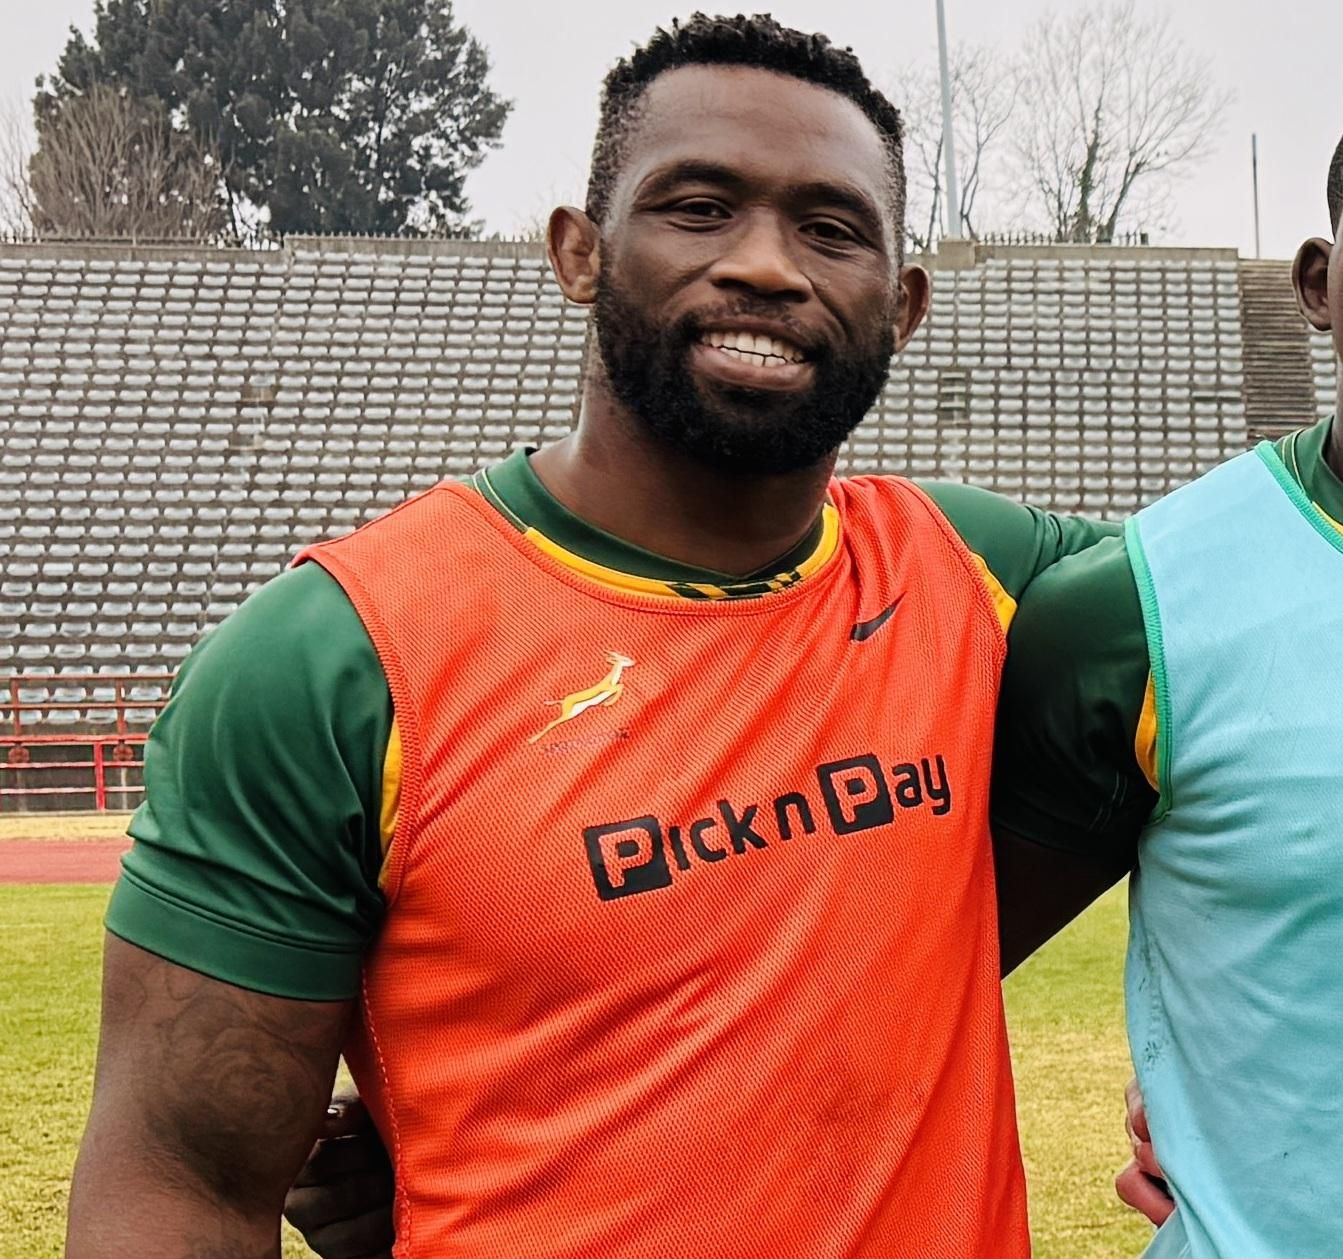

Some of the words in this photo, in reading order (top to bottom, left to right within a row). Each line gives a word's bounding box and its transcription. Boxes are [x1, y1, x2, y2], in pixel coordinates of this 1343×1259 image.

[583, 814, 766, 901] Pick
[774, 792, 817, 841] n
[817, 753, 951, 836] Pay
